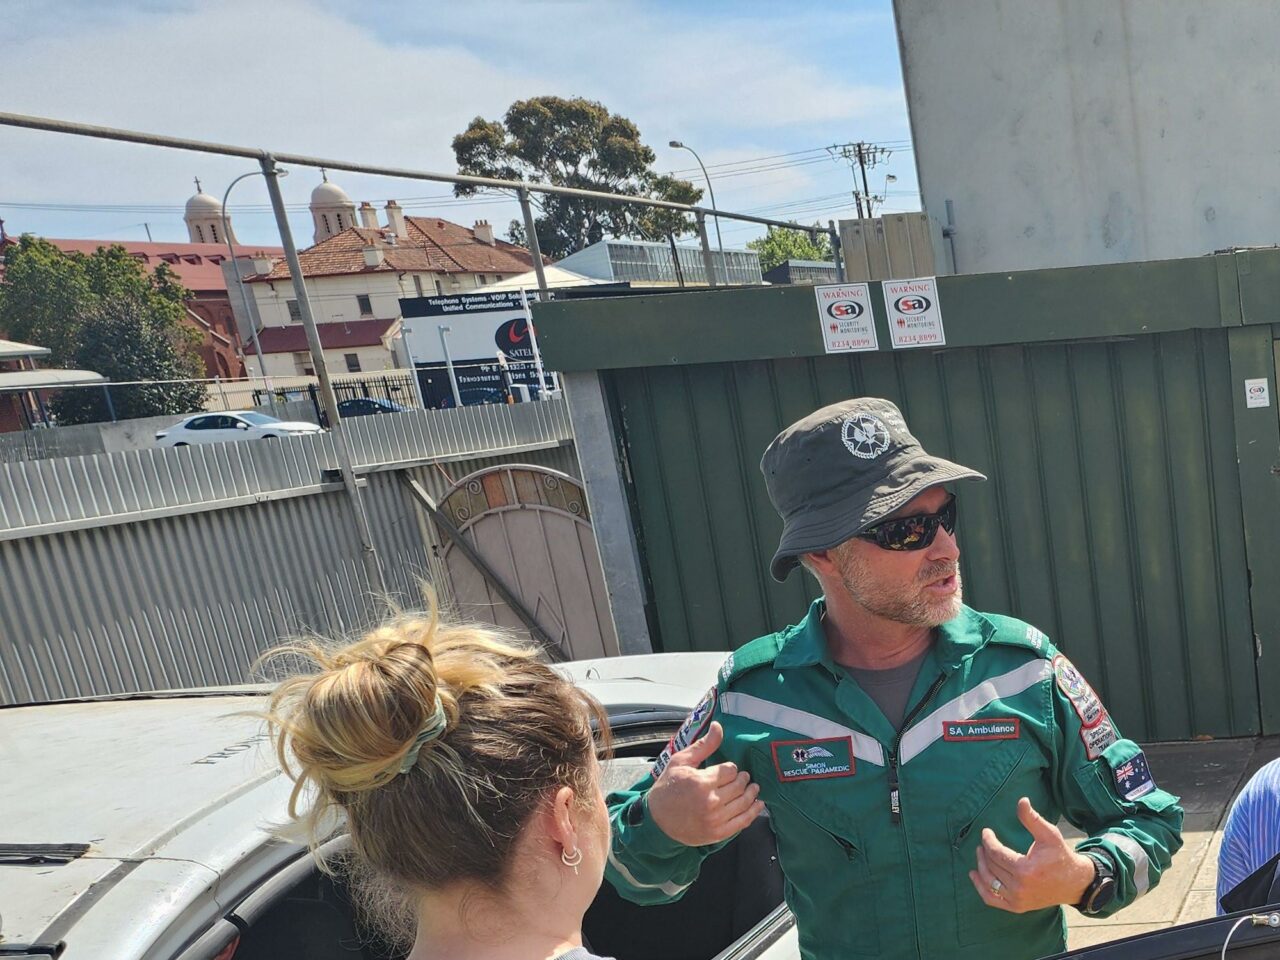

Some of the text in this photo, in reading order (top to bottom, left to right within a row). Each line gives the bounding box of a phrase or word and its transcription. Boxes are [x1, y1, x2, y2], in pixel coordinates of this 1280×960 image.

[890, 284, 930, 293] WARNING
[823, 290, 863, 299] WARNING
[461, 296, 487, 304] Systems
[442, 304, 463, 312] Unified
[465, 301, 514, 310] Communications
[907, 321, 935, 329] MONITORING
[840, 326, 868, 334] MONITORING
[949, 725, 1015, 736] SA Ambulance
[784, 765, 850, 777] RESCUE PARAMEDIC
